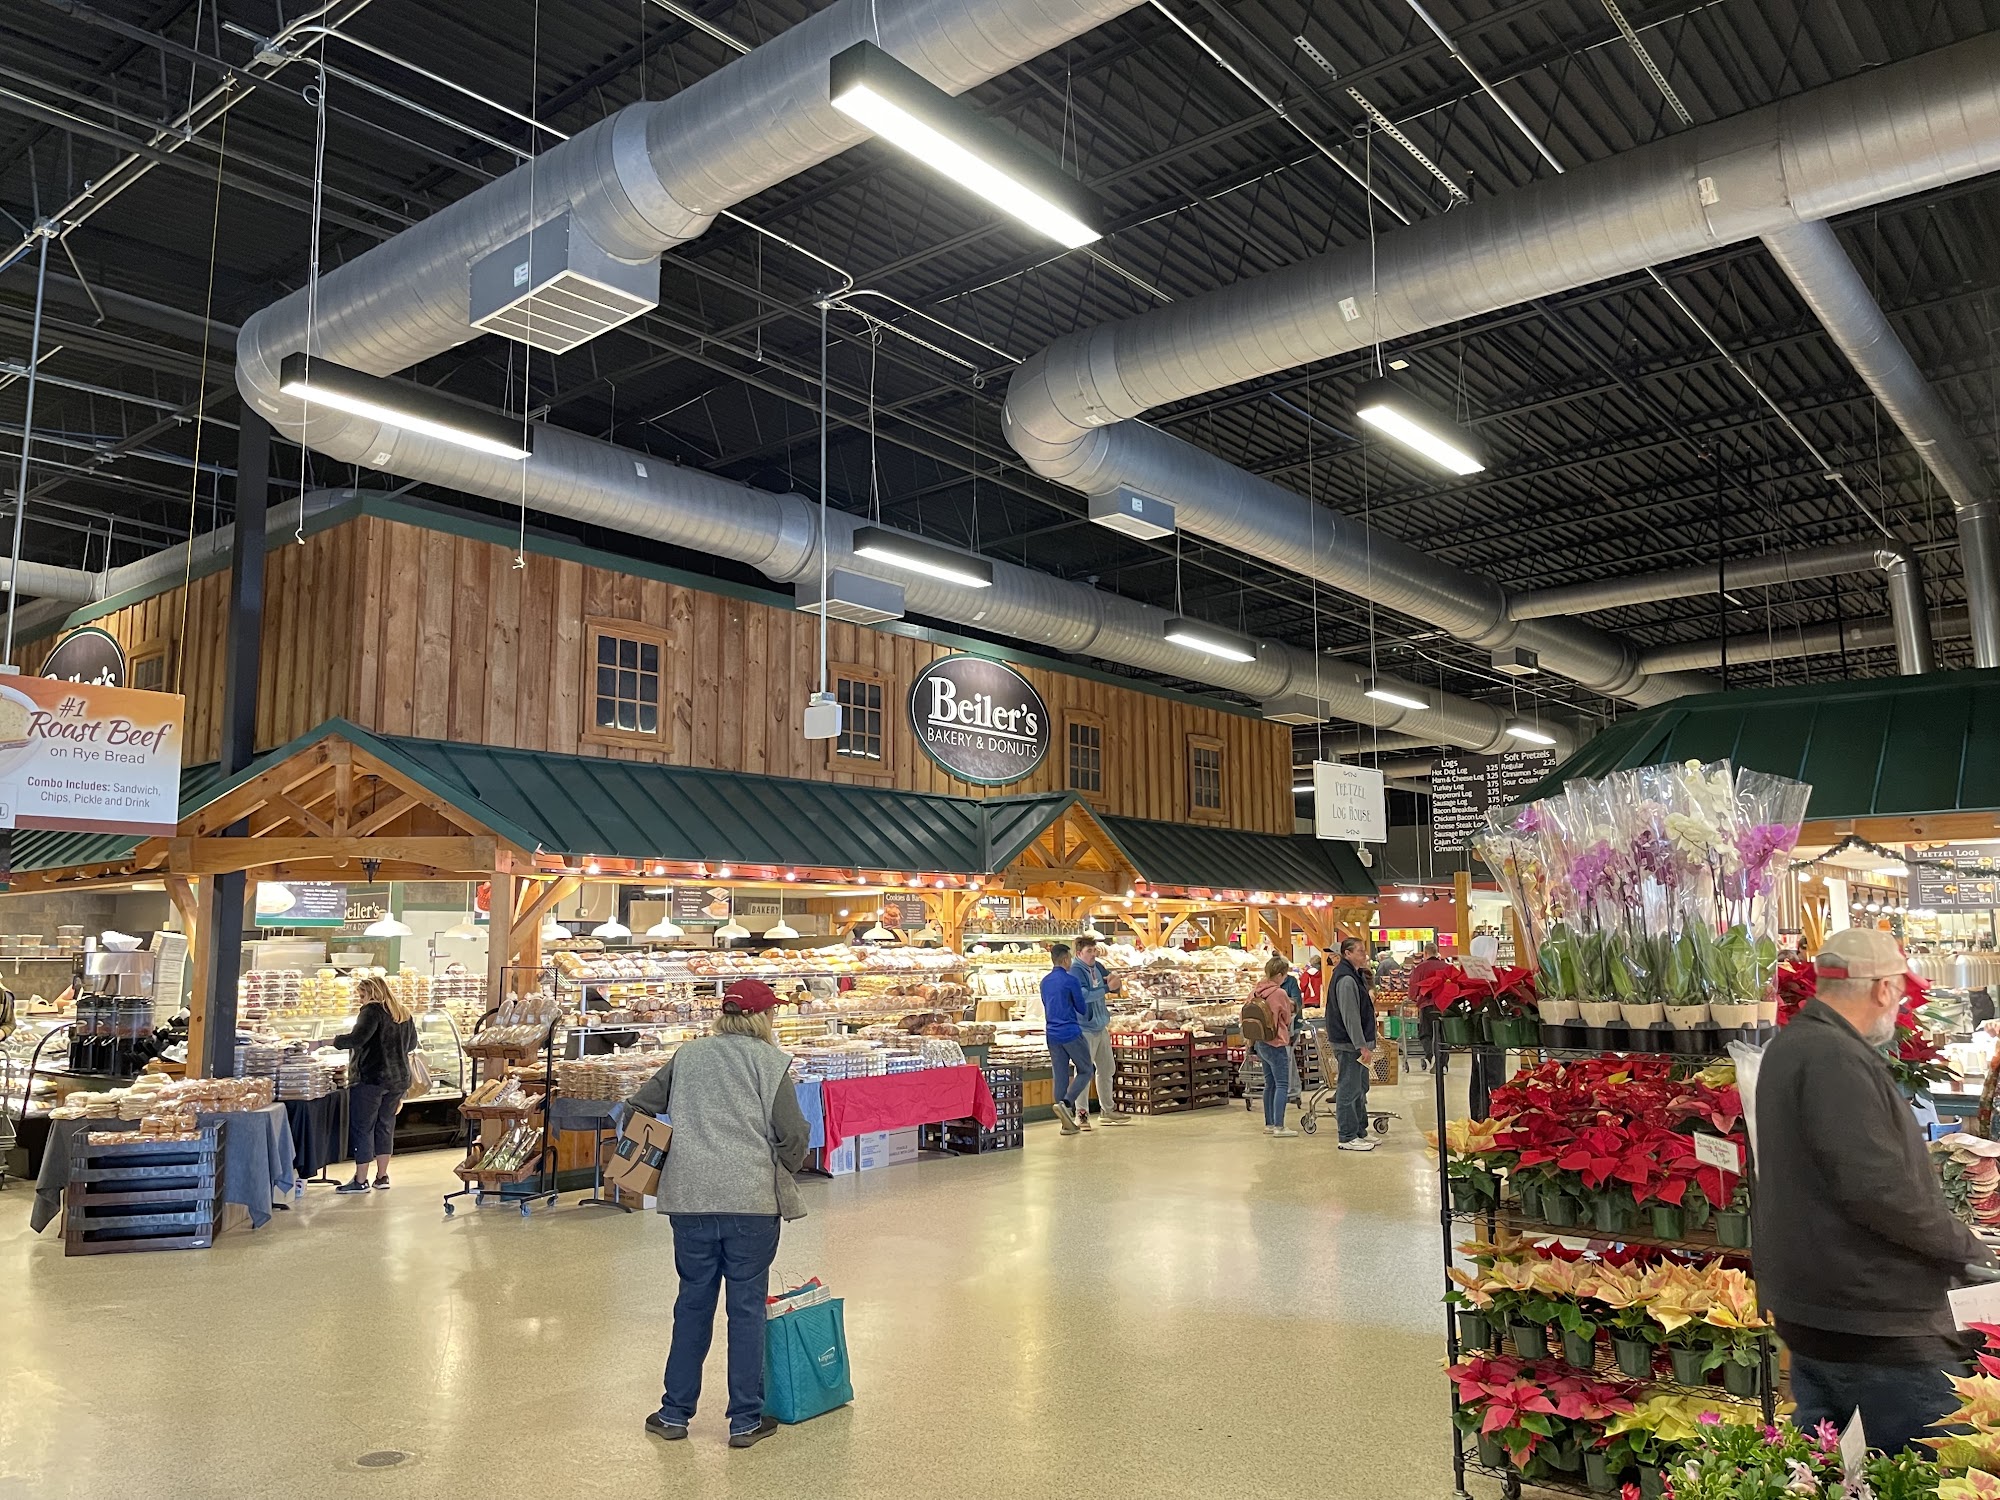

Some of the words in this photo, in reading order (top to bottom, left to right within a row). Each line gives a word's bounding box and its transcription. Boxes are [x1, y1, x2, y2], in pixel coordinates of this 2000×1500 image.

[59, 697, 87, 718] #1
[927, 676, 1038, 736] Beiler's
[27, 711, 102, 743] Roast
[107, 719, 172, 755] Beef
[927, 727, 972, 748] BAKERY
[976, 736, 984, 750] &
[988, 737, 1037, 758] DONUTS
[50, 747, 68, 757] on
[73, 747, 100, 763] Rye
[105, 751, 145, 765] Bread
[1503, 754, 1520, 762] Soft
[1521, 750, 1551, 760] Pretzels
[1440, 760, 1459, 768] Logs
[1501, 762, 1525, 771] Regular
[1443, 768, 1456, 776] Dog
[1456, 767, 1469, 775] Log
[1485, 764, 1499, 772] 3.25
[1501, 771, 1532, 779] Cinnamon
[1532, 768, 1551, 776] Sugar
[1473, 774, 1485, 782] Log
[1486, 772, 1500, 780] 3.25
[1502, 778, 1517, 787] Sour
[1518, 776, 1539, 785] Cream
[28, 776, 63, 789] Combo
[66, 779, 111, 793] Includes:
[113, 783, 161, 797] Sandwich,
[1432, 784, 1453, 792] Turkey
[1453, 783, 1465, 791] Log
[1487, 780, 1500, 788] 3.75
[41, 792, 71, 805] Chips,
[74, 793, 103, 805] Pickle
[105, 796, 122, 807] and
[125, 797, 150, 808] Drink
[1432, 791, 1461, 801] Pepperoni
[1461, 790, 1473, 798] Log
[1487, 788, 1500, 797] 3.75
[1433, 799, 1457, 808] Sausage
[1457, 798, 1469, 806] Log
[1433, 807, 1451, 815] Bacon
[1451, 805, 1479, 814] Breakfast
[1433, 815, 1457, 823] Chicken
[1457, 814, 1476, 822] Bacon
[1456, 821, 1473, 829] Steak
[1434, 830, 1459, 839] Sausage
[1433, 838, 1452, 847] Cajun
[1434, 845, 1464, 853] Cinnamon
[1917, 850, 1954, 858] PRETZEL
[1956, 849, 1980, 857] LOGS
[751, 905, 780, 915] BAKERY
